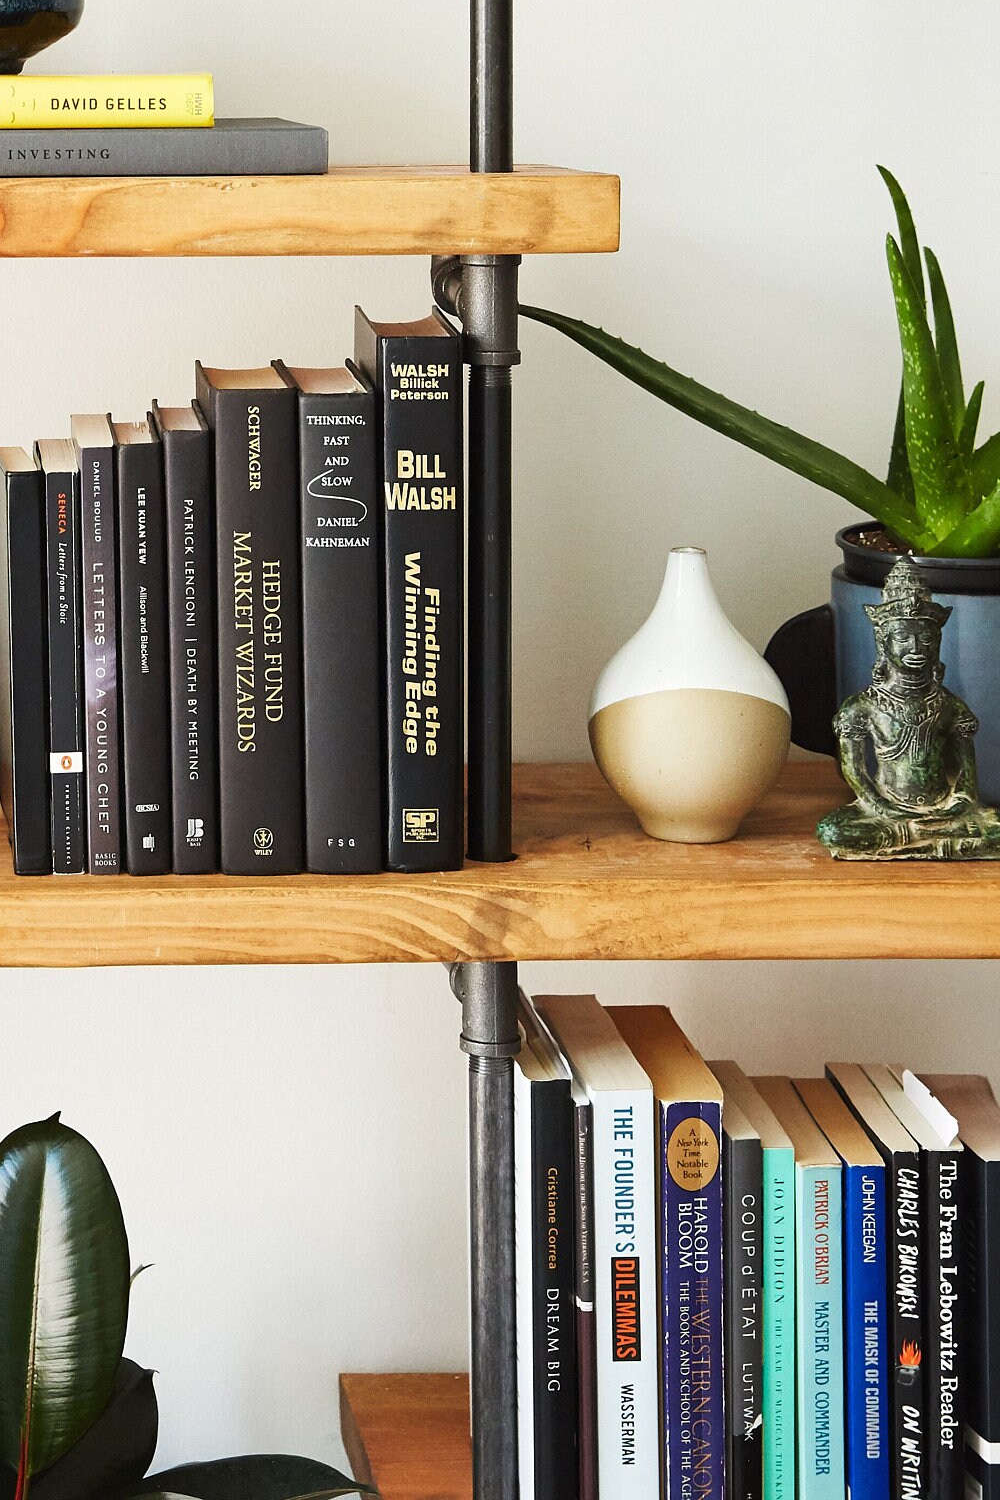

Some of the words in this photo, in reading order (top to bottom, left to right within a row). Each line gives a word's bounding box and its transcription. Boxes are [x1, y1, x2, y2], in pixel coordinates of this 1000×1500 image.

[51, 99, 97, 110] DAVID
[106, 98, 166, 110] GELLES
[9, 149, 110, 159] INVESTING
[306, 416, 365, 425] THINKING,
[324, 436, 349, 445] FAST
[321, 477, 353, 486] SLOW
[325, 457, 349, 465] AND
[398, 450, 446, 478] BILL
[384, 481, 455, 512] WALSH
[138, 510, 146, 538] KUAN
[304, 536, 370, 548] KAHNEMAN
[317, 518, 358, 526] DANIEL
[234, 531, 253, 634] MARKET
[263, 560, 281, 645] HEDGE
[403, 552, 420, 675] Winning
[423, 588, 440, 696] Finding
[236, 640, 255, 751] WIZARDS
[265, 653, 283, 721] FUND
[403, 682, 421, 753] Edge
[426, 706, 440, 755] the
[614, 1106, 633, 1140] THE
[548, 1168, 558, 1223] Cristiane
[615, 1149, 635, 1252] FOUNDER'S
[815, 1180, 828, 1230] PATRICK
[862, 1176, 875, 1210] JOHN
[897, 1169, 919, 1237] CHARLES
[940, 1161, 957, 1199] The
[549, 1228, 558, 1269] Correa
[679, 1203, 692, 1268] BLOOM
[694, 1198, 708, 1273] HAROLD
[742, 1195, 755, 1256] COUP
[863, 1214, 876, 1262] KEEGAN
[940, 1204, 957, 1259] Fran
[815, 1234, 829, 1284] O'BRIAN
[896, 1244, 919, 1318] BUKOWSKI
[547, 1289, 559, 1352] DREAM
[616, 1260, 636, 1358] DILEMMAS
[815, 1302, 829, 1353] MASTER
[864, 1301, 878, 1323] THE
[940, 1266, 958, 1370] Lebowitz
[865, 1327, 878, 1365] MASK
[548, 1362, 560, 1391] BIG
[815, 1359, 829, 1385] AND
[865, 1369, 878, 1384] OF
[621, 1384, 635, 1464] WASSERMAN
[815, 1392, 830, 1475] COMMANDER
[866, 1388, 880, 1458] COMMAND
[941, 1376, 958, 1449] Reader
